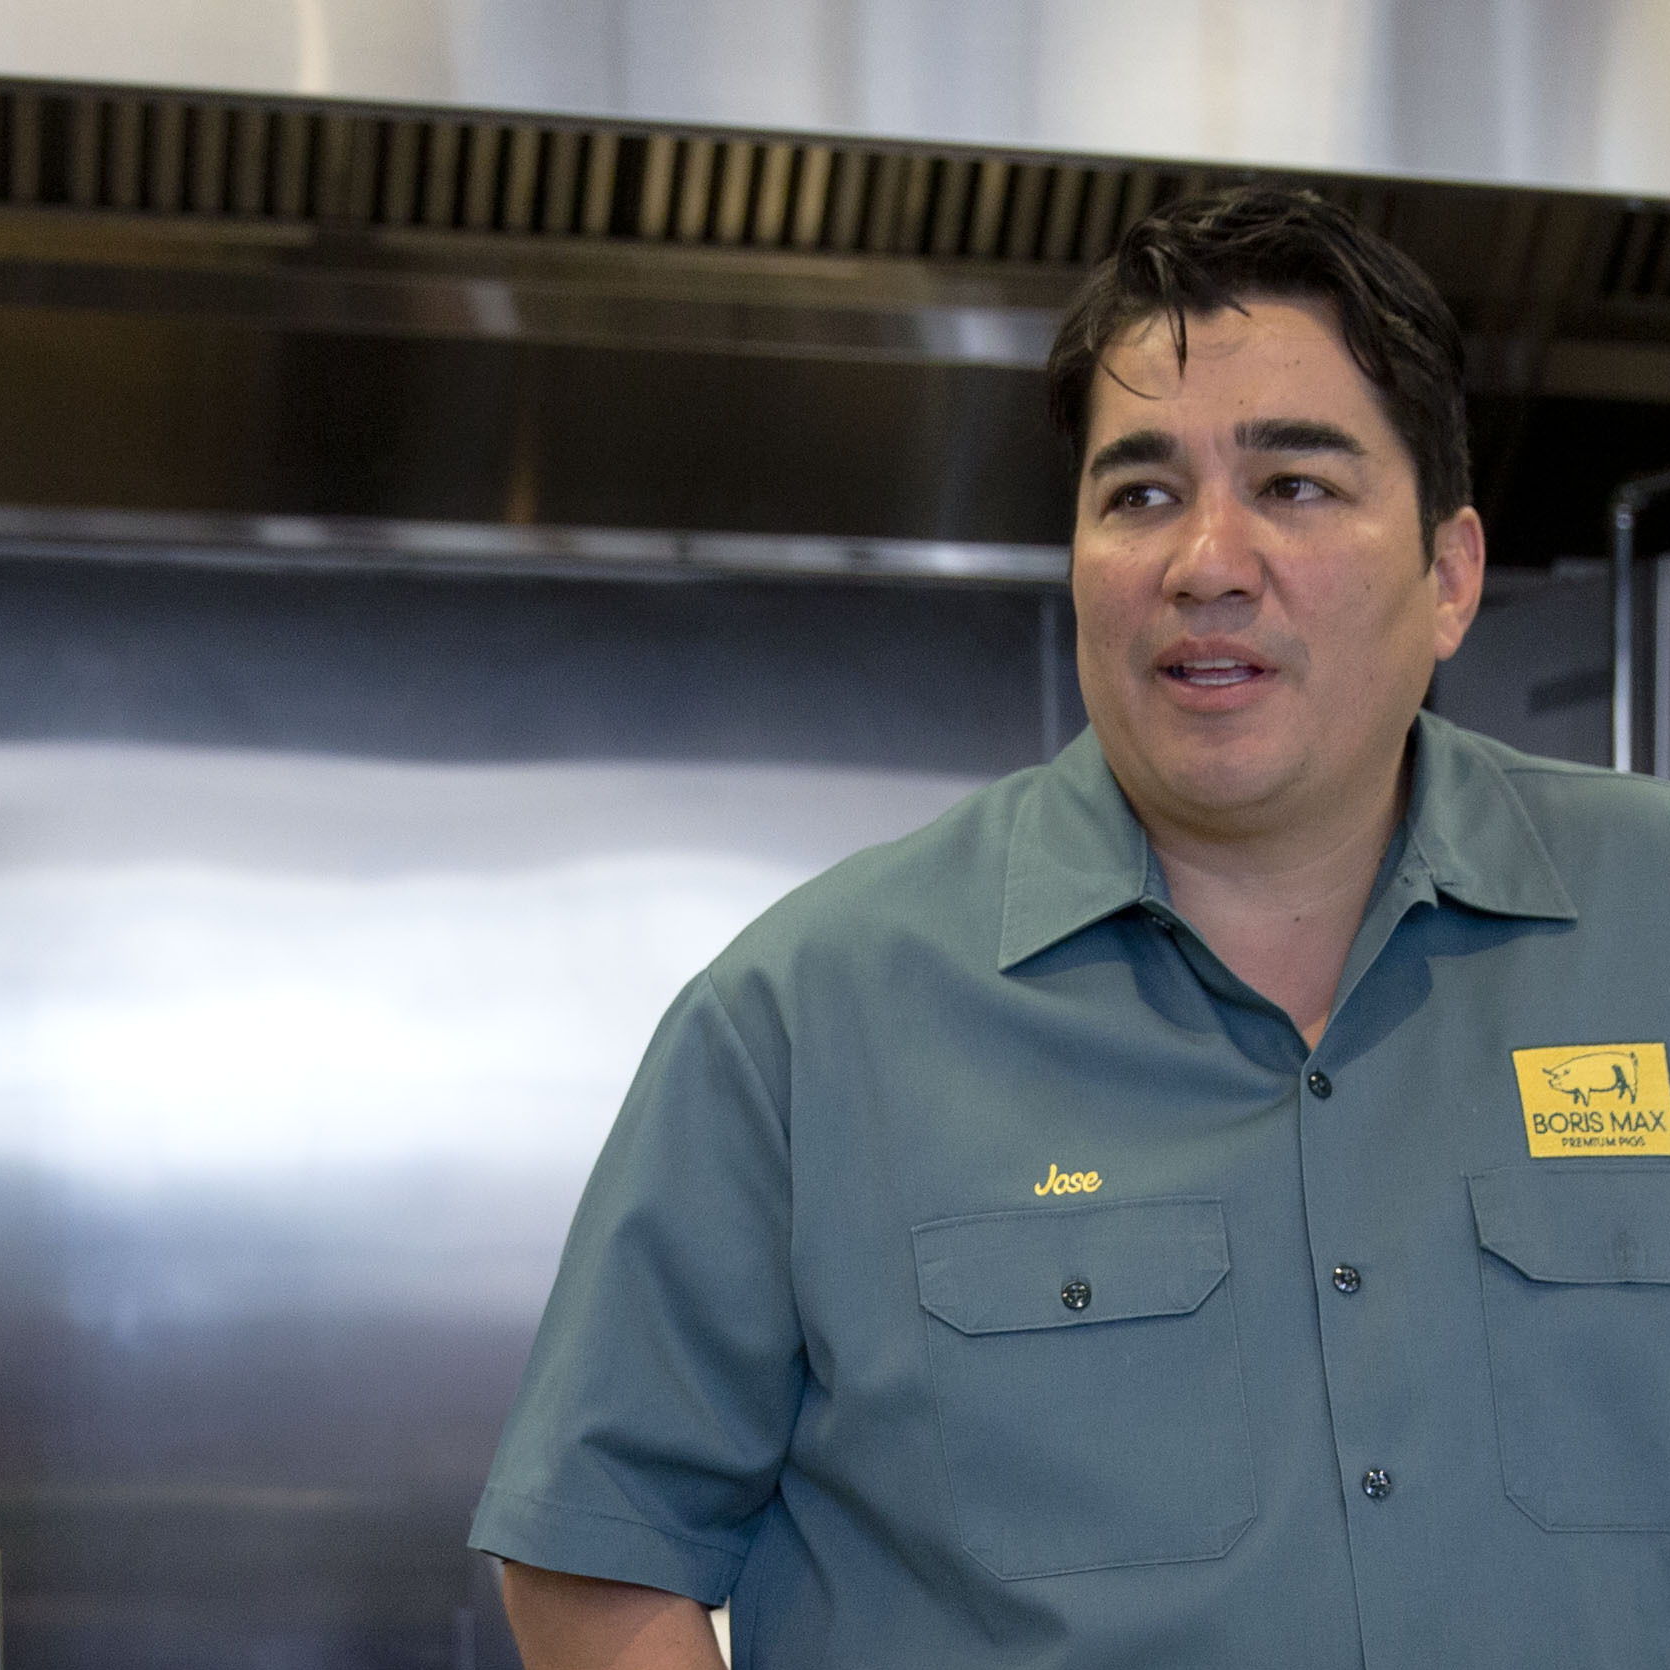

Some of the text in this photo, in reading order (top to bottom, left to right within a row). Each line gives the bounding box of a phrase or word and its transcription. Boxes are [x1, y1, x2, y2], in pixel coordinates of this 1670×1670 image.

[1532, 1110, 1667, 1135] BORIS MAX
[1561, 1136, 1646, 1148] PREMIUM PIGS
[1034, 1163, 1103, 1196] Jose
